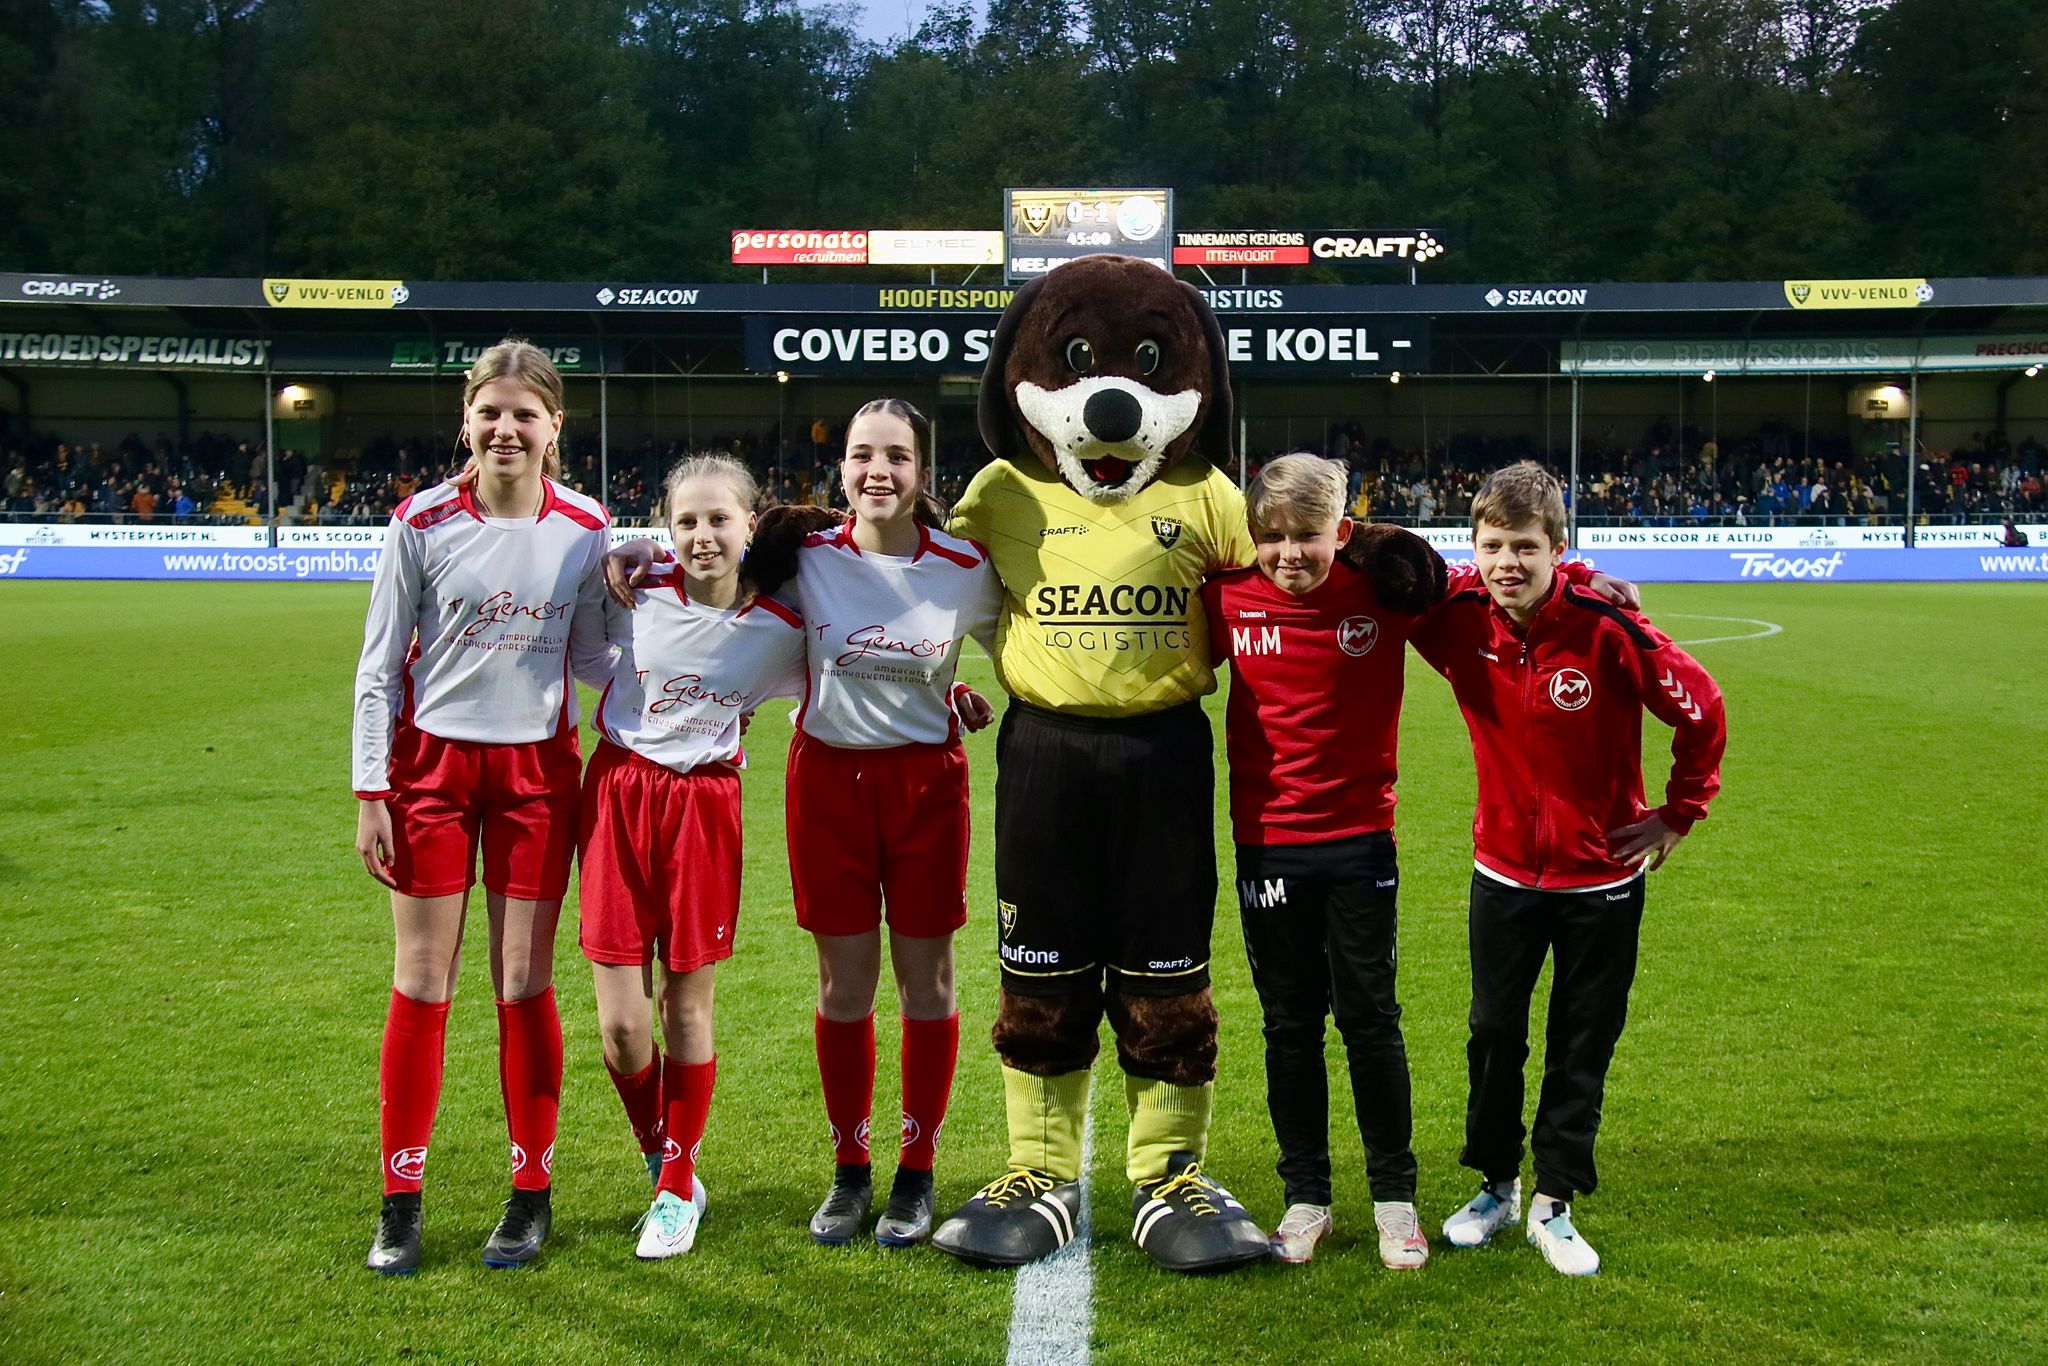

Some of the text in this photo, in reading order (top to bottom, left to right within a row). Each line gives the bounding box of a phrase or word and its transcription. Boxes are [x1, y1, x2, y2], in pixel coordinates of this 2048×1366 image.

[732, 231, 867, 254] personato
[893, 238, 977, 248] ELMEC
[1177, 233, 1304, 246] TINNEMANS KEUKENS
[1312, 237, 1415, 258] CRAFT
[793, 251, 867, 263] recruitment
[1205, 249, 1276, 262] ITTERVOORT
[21, 280, 99, 298] CRAFT
[299, 287, 385, 300] VVV-VENLO
[617, 289, 699, 305] SEACON
[1507, 289, 1587, 306] SEACON
[1820, 287, 1908, 300] VVV-VENLO
[879, 289, 1015, 308] HOOFDSPON
[1199, 289, 1283, 308] ISTICS
[0, 332, 273, 366] TGOEDSPECIALIST
[773, 328, 950, 362] COVEBO
[1266, 328, 1379, 362] KOEL
[1580, 340, 1882, 368] LEO BEURSKENS
[1975, 339, 2048, 356] PRECISIO
[291, 532, 319, 542] ONS
[326, 532, 373, 542] SCOOR
[1039, 526, 1078, 537] CRAFT
[1591, 532, 1773, 543] BIJ ONS SCOOR JE ALTIJD
[162, 550, 378, 577] www.troost-gmbh.d
[1729, 551, 1843, 577] Troost
[1035, 584, 1191, 617] SEACON
[1045, 630, 1191, 651] LOGISTICS
[1231, 625, 1282, 657] MvM
[1148, 959, 1185, 969] CRAFT
